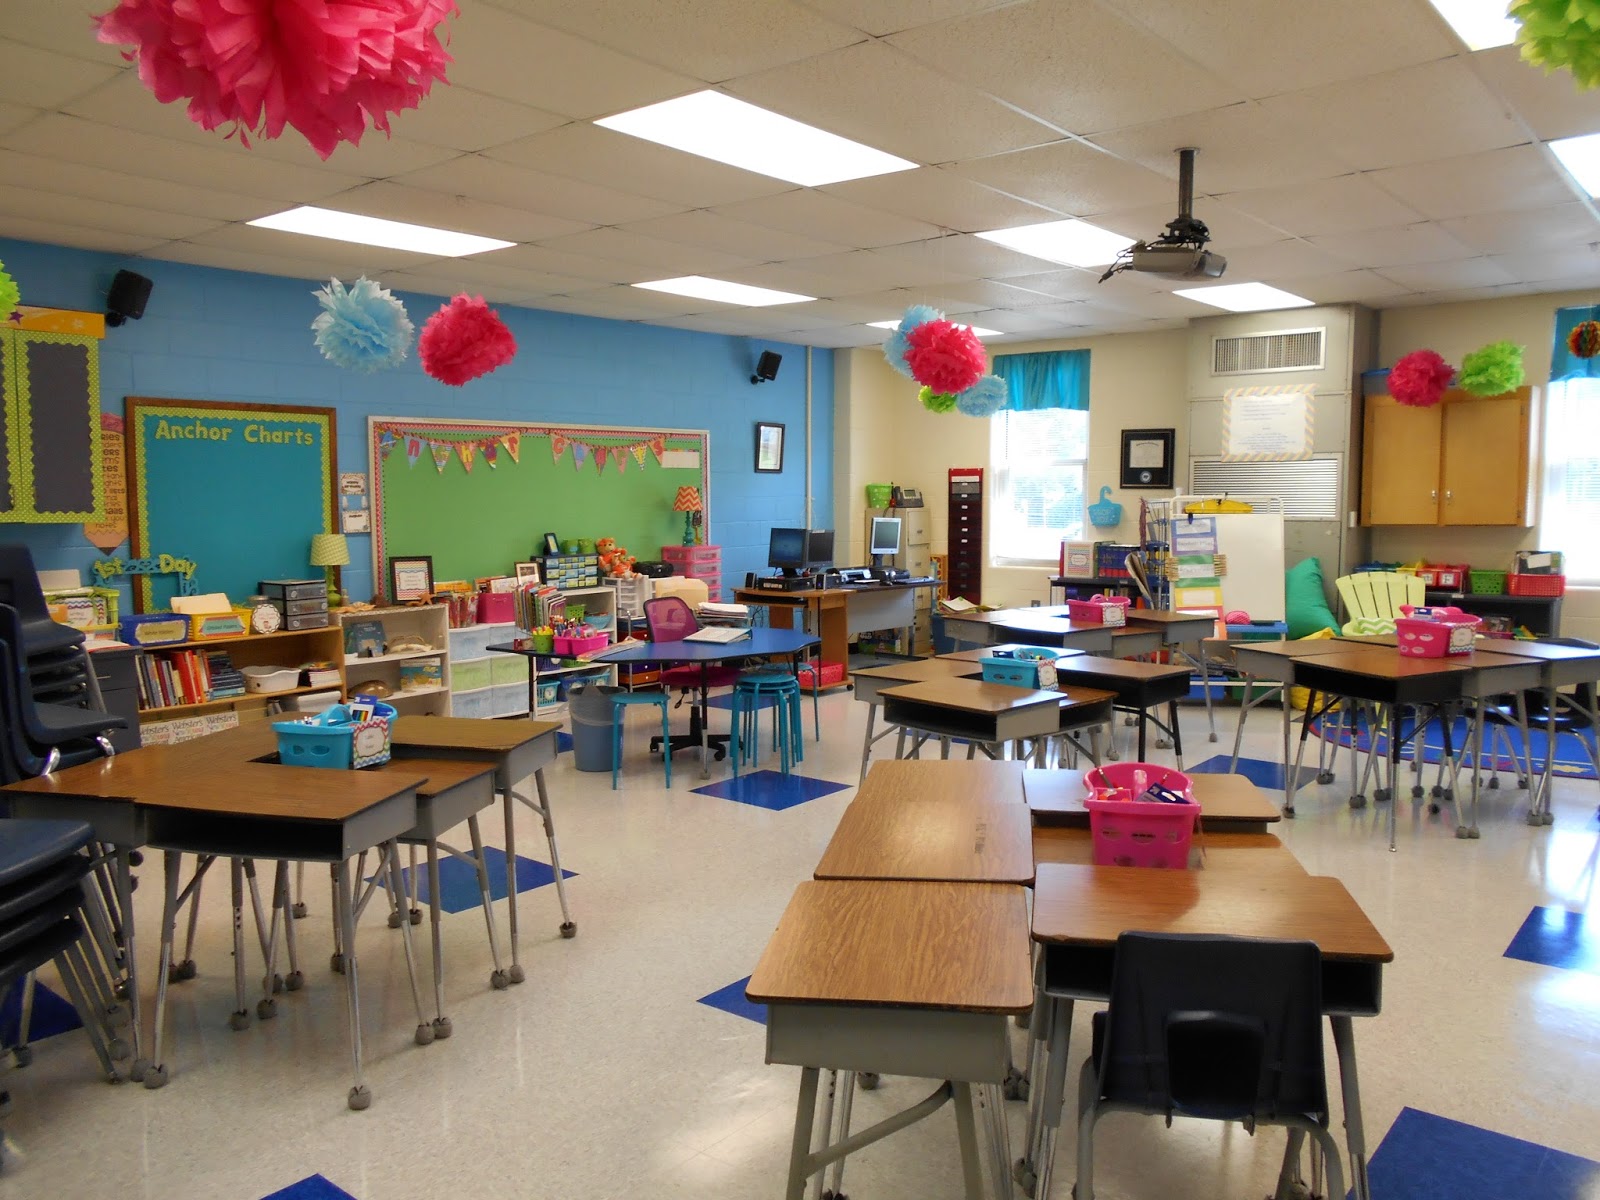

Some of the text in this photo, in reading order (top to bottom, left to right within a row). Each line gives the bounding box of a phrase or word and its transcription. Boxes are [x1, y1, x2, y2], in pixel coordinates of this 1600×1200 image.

[155, 420, 314, 446] Anchor Charts
[94, 553, 197, 580] 1st Day
[140, 724, 170, 735] ebster's
